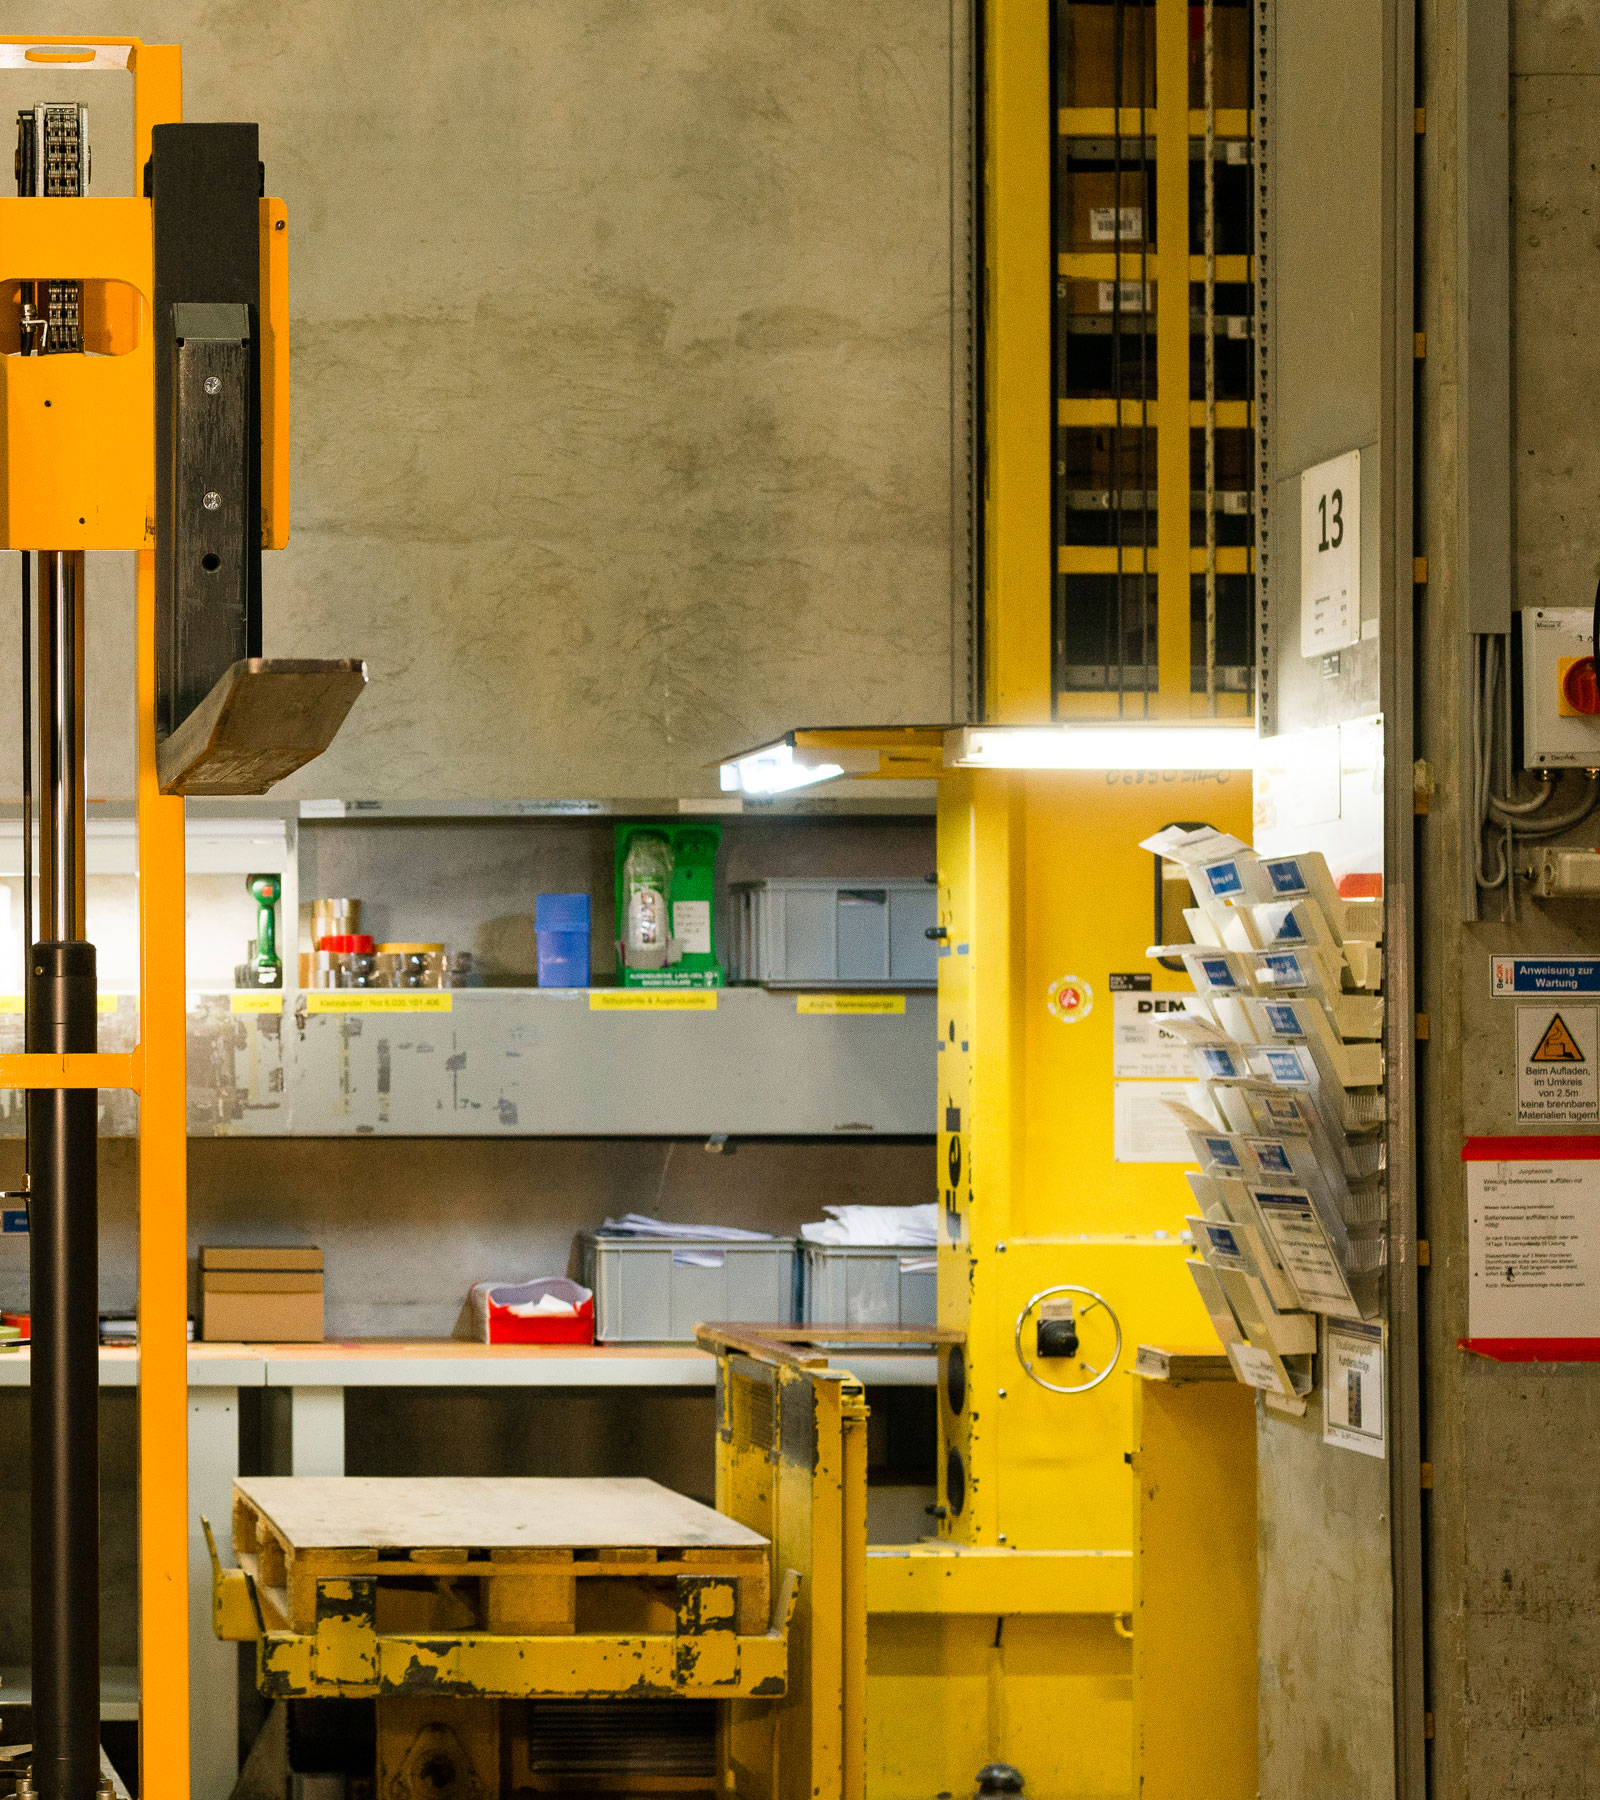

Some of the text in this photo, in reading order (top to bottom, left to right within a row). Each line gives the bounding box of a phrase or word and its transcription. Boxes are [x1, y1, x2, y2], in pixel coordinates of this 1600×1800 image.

[1318, 488, 1344, 553] 13
[1519, 965, 1594, 976] Anweisung zur
[1535, 978, 1578, 989] Wartung
[1137, 1000, 1186, 1013] DEM
[1525, 1066, 1591, 1077] Beim Aufladen,
[1534, 1077, 1583, 1086] im Umkreis
[1538, 1088, 1579, 1097] von 2.5m
[1521, 1100, 1596, 1108] keine brennbaren
[1518, 1110, 1566, 1120] Materialien
